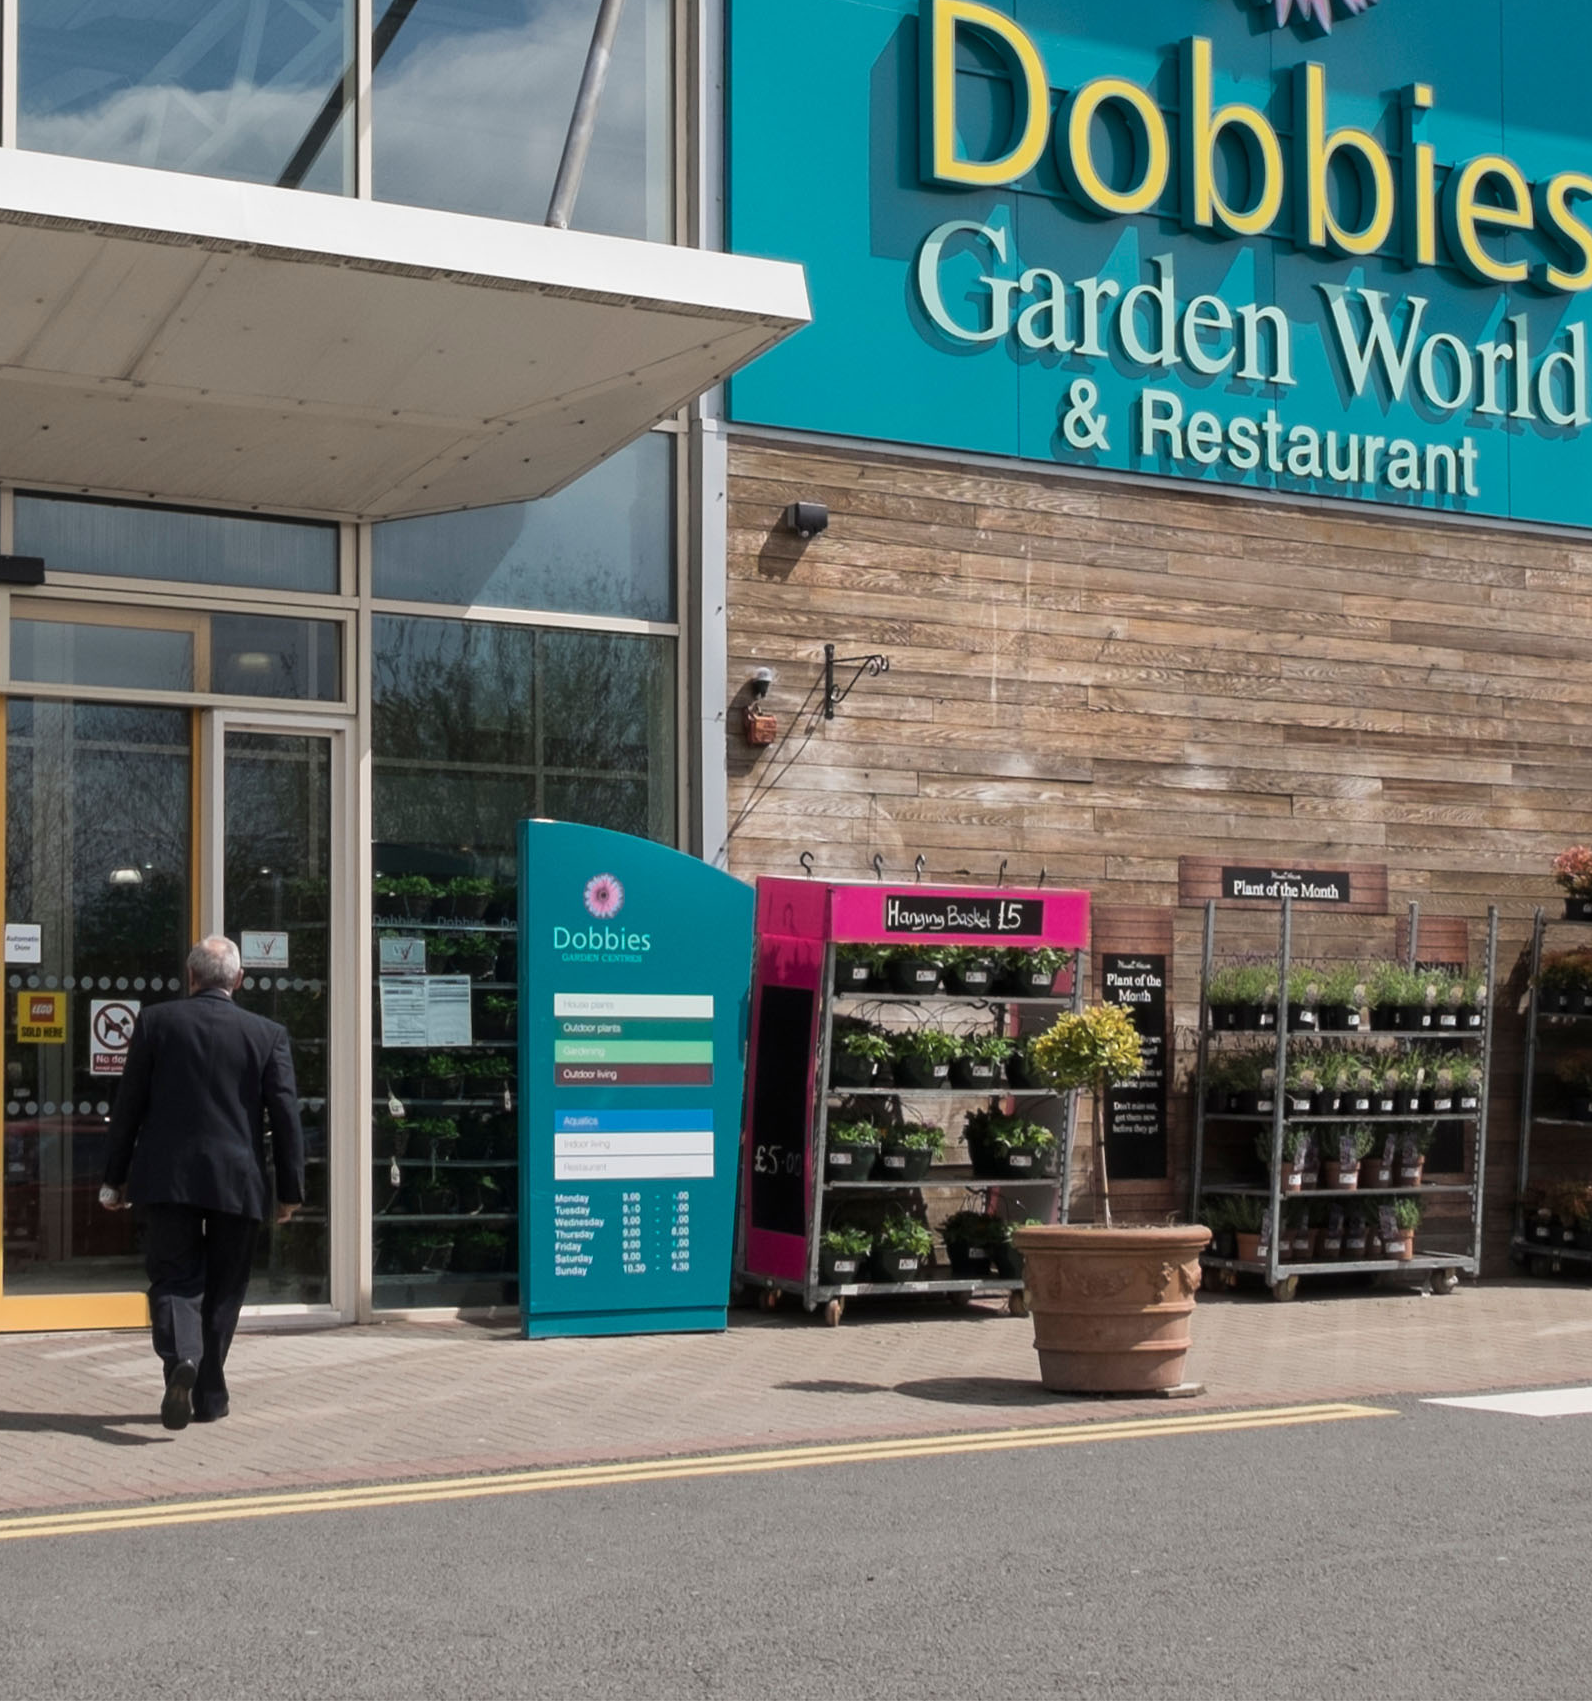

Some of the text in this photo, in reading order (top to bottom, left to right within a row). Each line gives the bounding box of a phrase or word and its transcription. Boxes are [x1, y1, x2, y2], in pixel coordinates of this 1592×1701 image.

[917, 220, 1591, 429] Garden World
[1063, 379, 1479, 497] & Restaurant
[1233, 880, 1339, 899] Plant of the Month
[887, 899, 1023, 931] Hanging Basket £5
[6, 935, 39, 943] Automatic
[554, 926, 651, 950] Dobbies
[562, 953, 642, 963] GARDEN CENTRES
[1106, 973, 1162, 987] Plant of the
[1119, 989, 1151, 1002] Month
[32, 1004, 53, 1015] LEGO
[563, 1000, 614, 1011] House plants
[21, 1027, 64, 1038] SOLD HERE
[563, 1022, 621, 1035] Outdoor plants
[563, 1046, 606, 1058] Gardening
[96, 1054, 110, 1063] No
[563, 1069, 617, 1081] Outdoor living
[563, 1116, 598, 1127] Aquatics
[563, 1139, 610, 1150] Indoor living
[563, 1162, 607, 1172] Restaurant
[554, 1193, 589, 1204] Monday
[554, 1206, 590, 1216] Tuesday
[554, 1218, 605, 1228] Wednesday
[554, 1230, 594, 1240] Thursday
[554, 1242, 582, 1253] Friday
[554, 1254, 593, 1265] Saturday
[554, 1266, 587, 1277] Sunday
